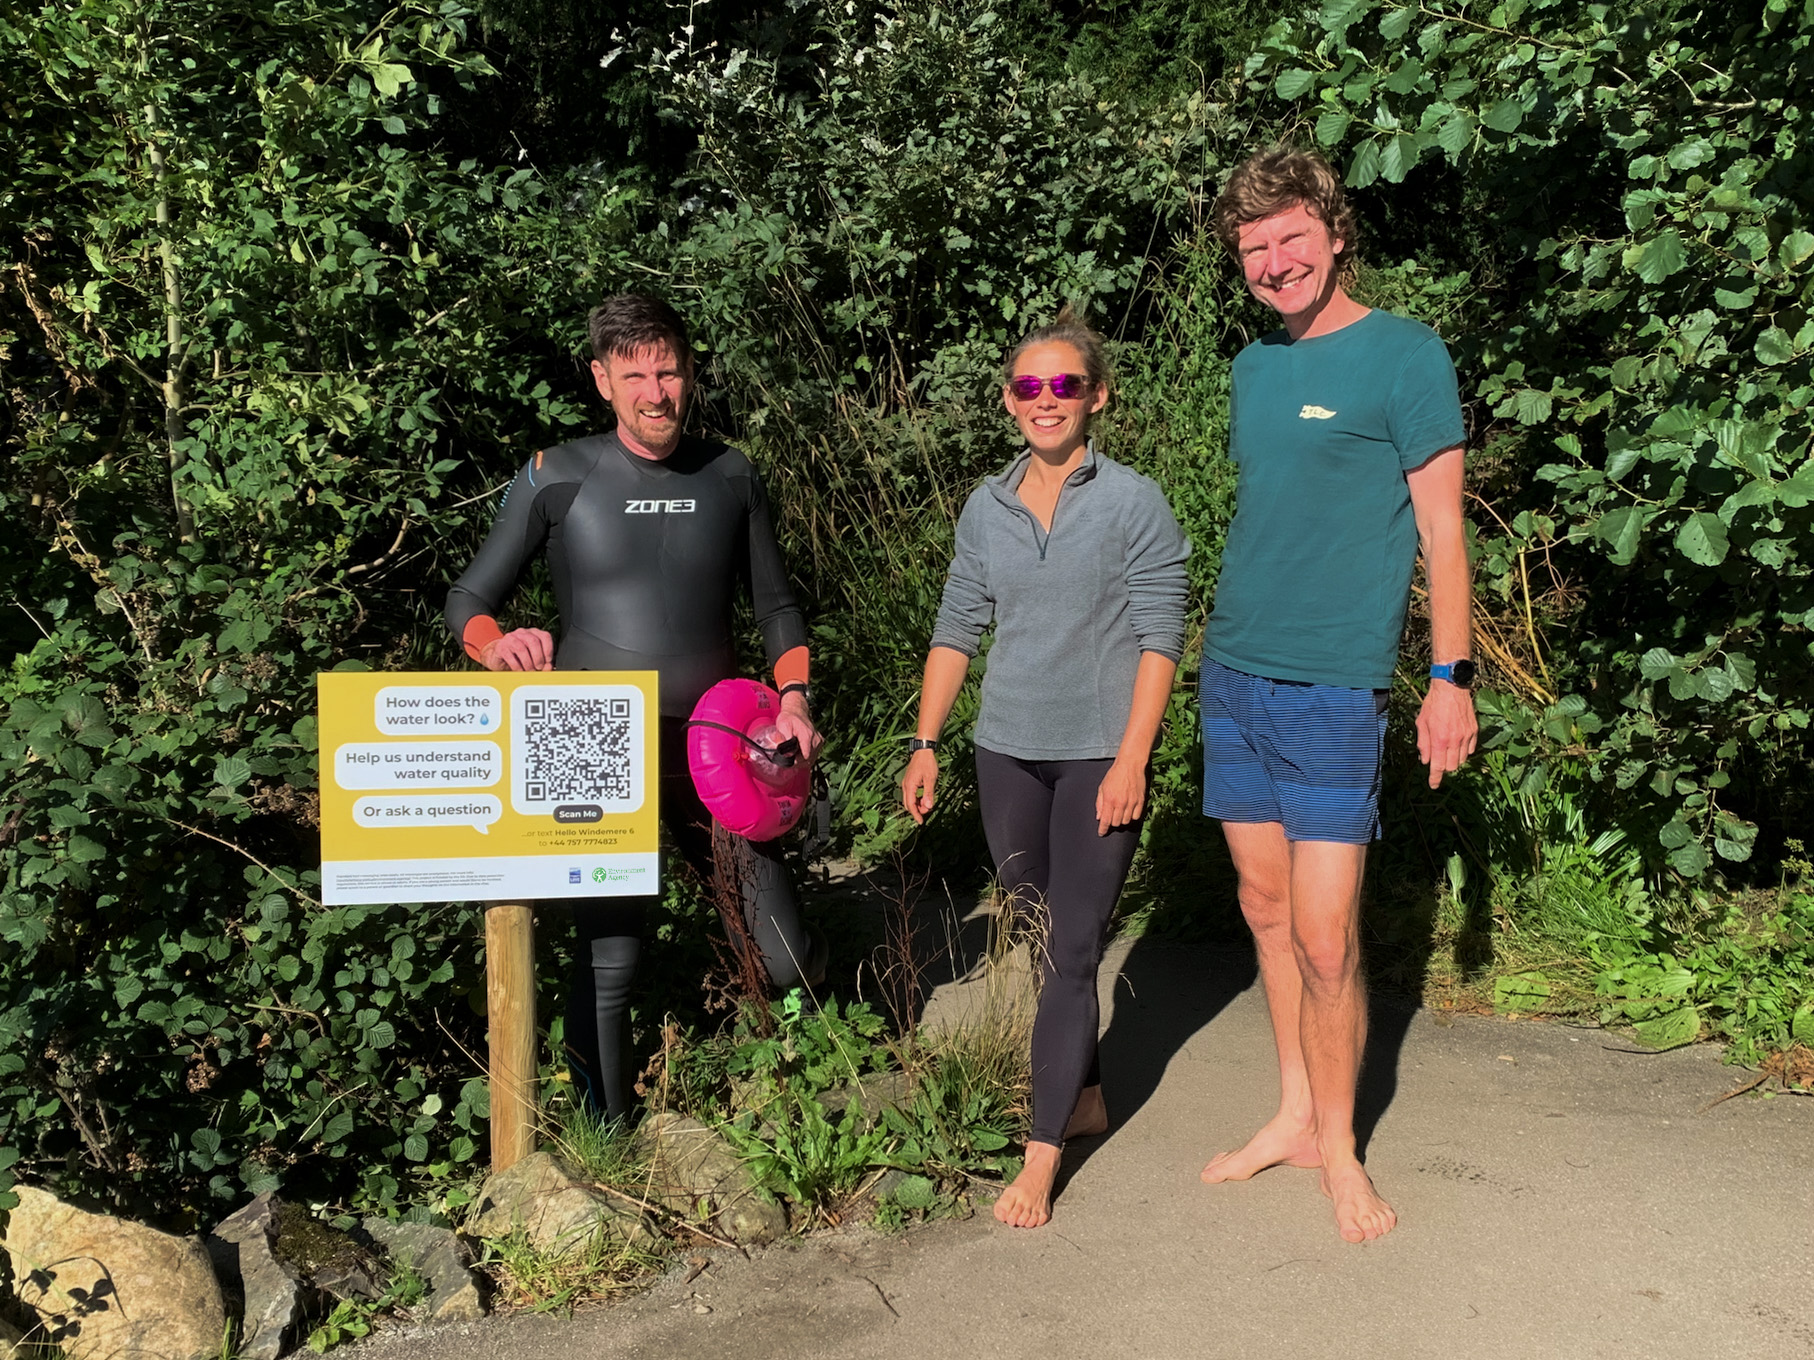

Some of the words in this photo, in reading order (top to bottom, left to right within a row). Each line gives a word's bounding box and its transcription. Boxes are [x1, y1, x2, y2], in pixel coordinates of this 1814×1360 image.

[624, 499, 696, 514] ZONE3
[386, 697, 421, 708] How
[425, 697, 461, 708] does
[464, 696, 490, 707] the
[386, 715, 430, 725] water
[434, 713, 475, 724] look?
[346, 752, 380, 765] Help
[384, 754, 402, 763] us
[406, 750, 491, 762] understand
[394, 769, 437, 779] water
[440, 766, 491, 780] quality
[363, 806, 381, 817] Or
[385, 805, 411, 816] ask
[414, 807, 423, 816] a
[427, 803, 491, 818] question
[559, 810, 581, 819] Scan
[583, 810, 597, 818] Me
[578, 828, 627, 836] Windemere
